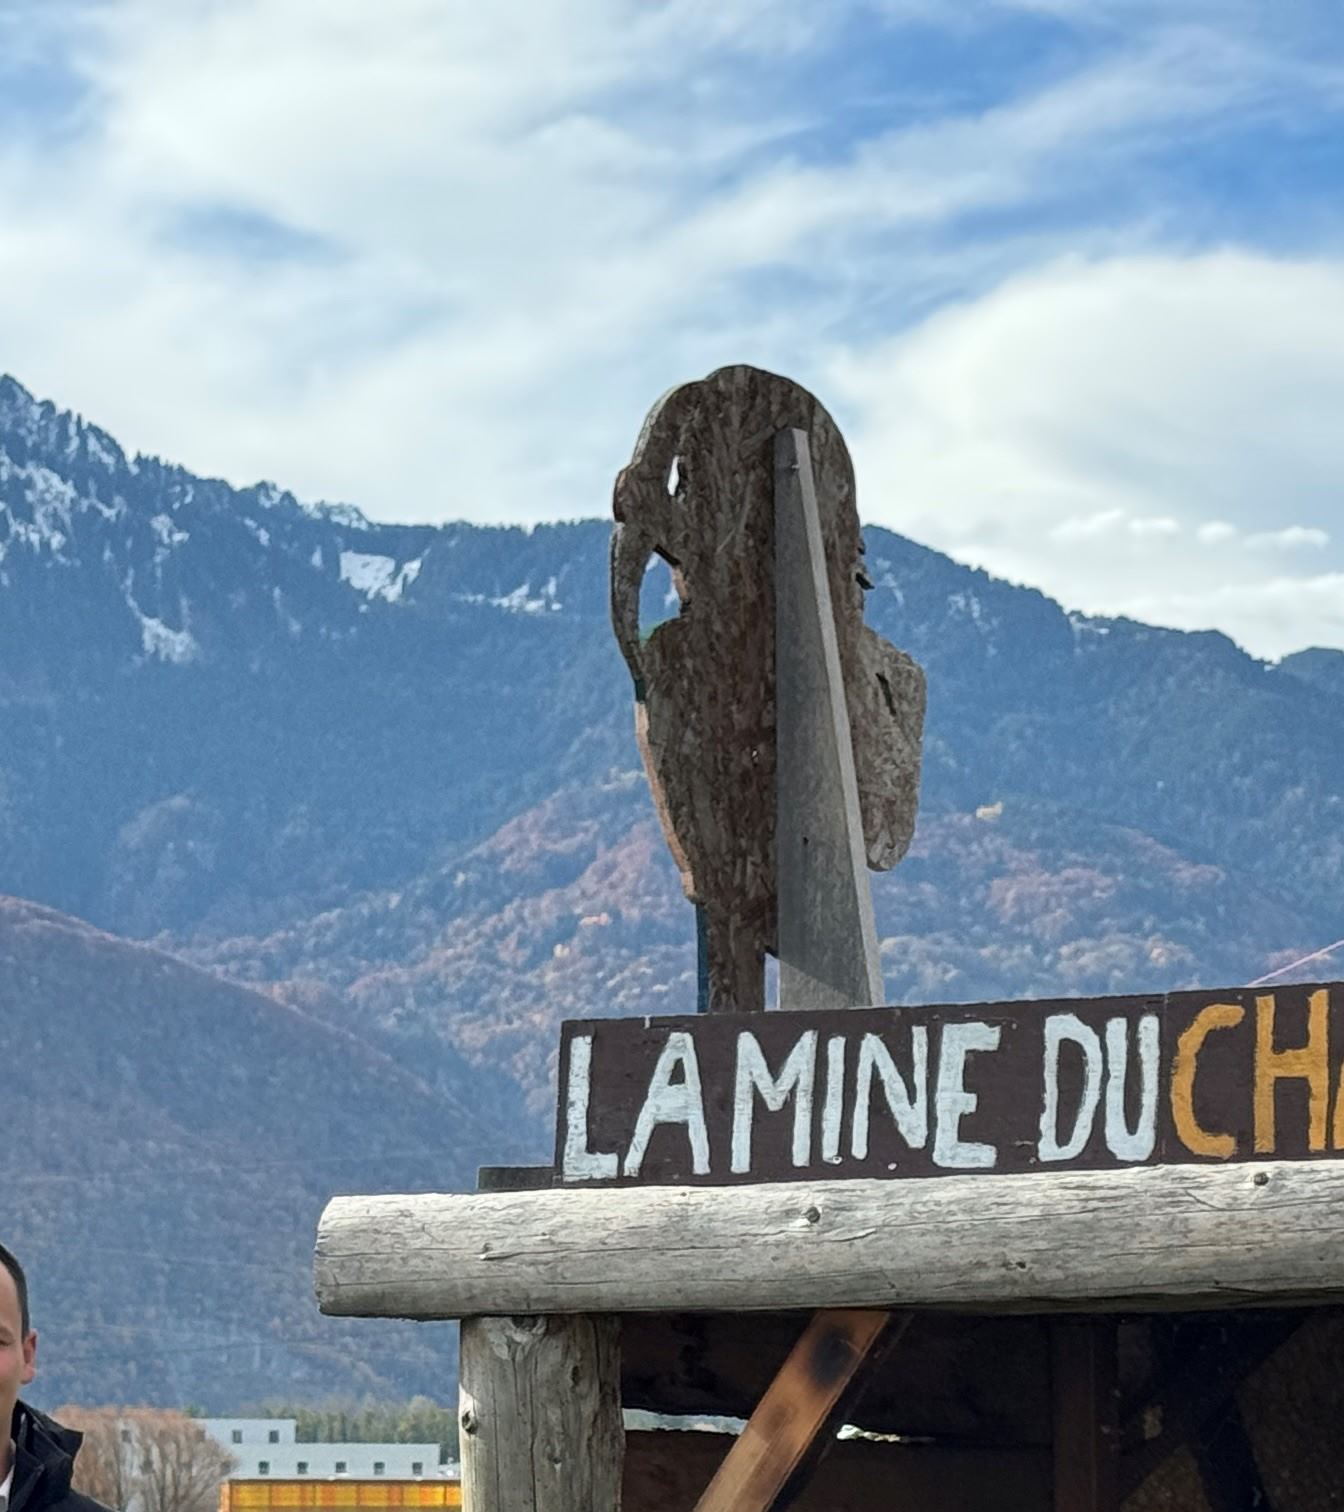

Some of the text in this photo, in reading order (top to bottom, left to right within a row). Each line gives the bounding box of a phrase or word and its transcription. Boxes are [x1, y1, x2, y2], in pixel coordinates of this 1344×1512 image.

[562, 1031, 710, 1182] LA
[730, 1020, 1001, 1175] MINE
[1038, 1013, 1160, 1162] DU
